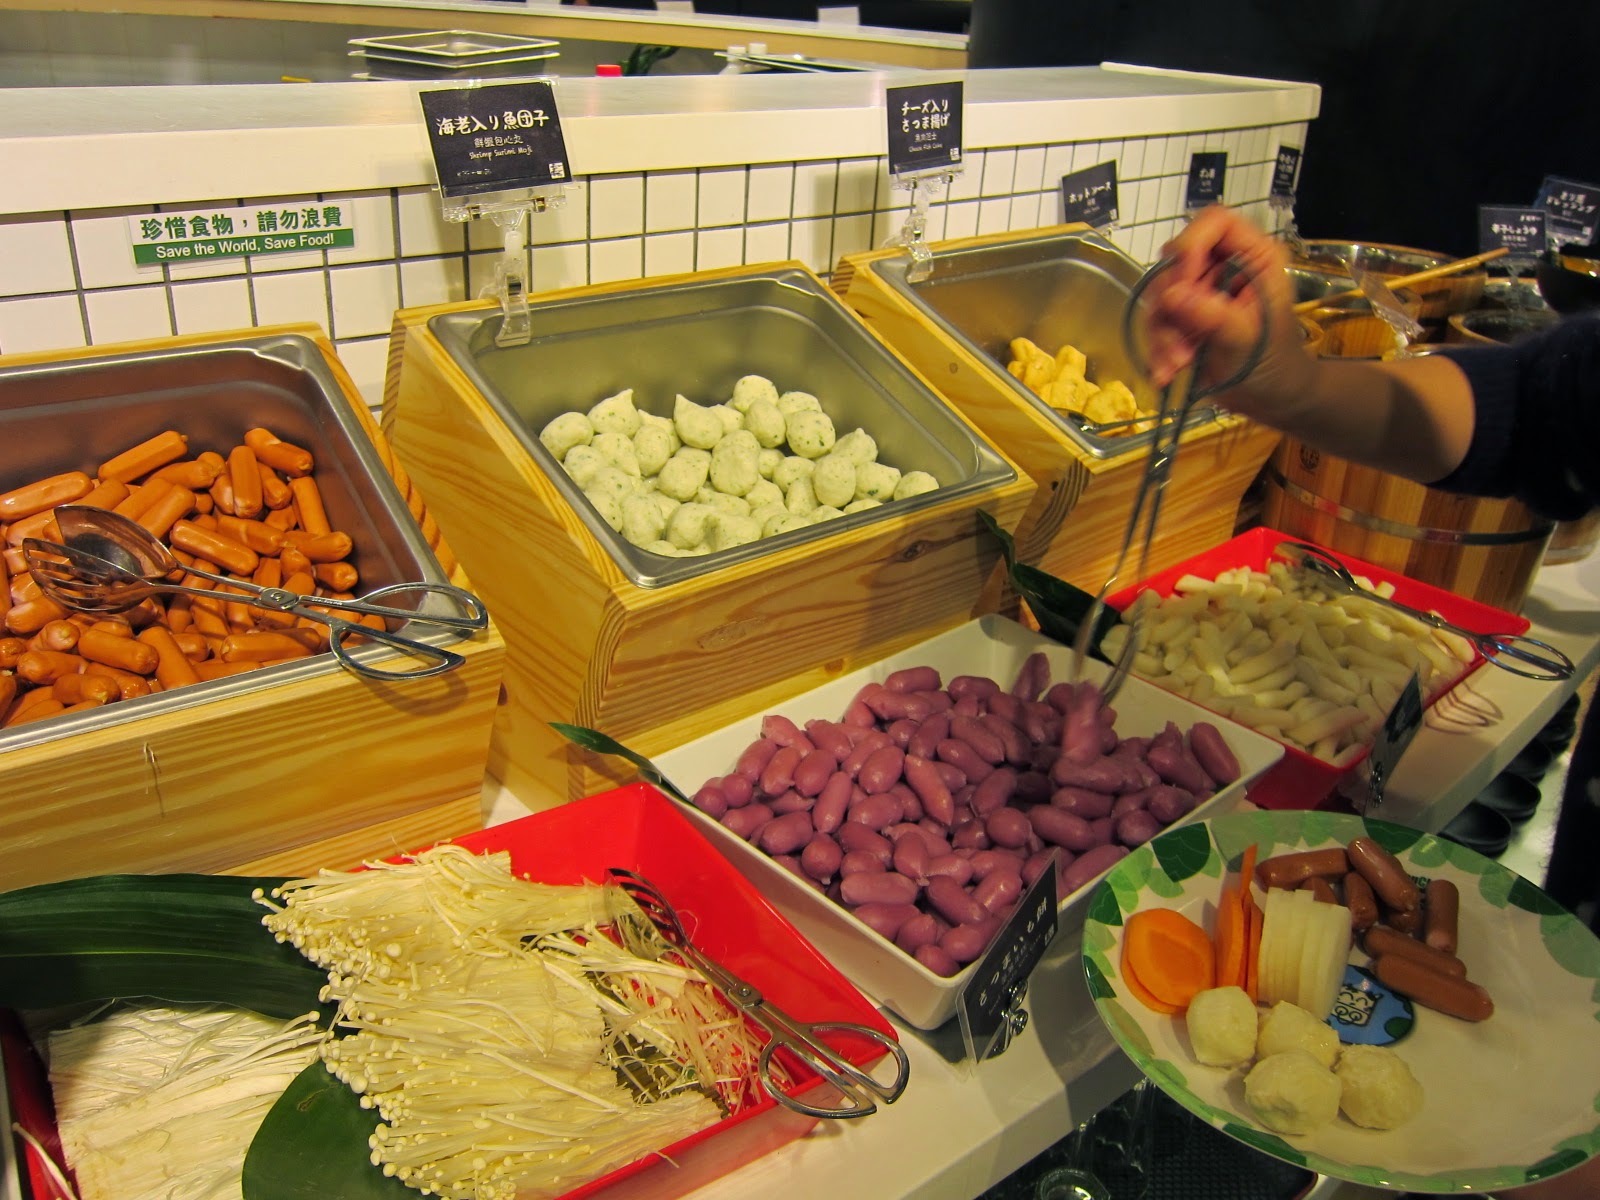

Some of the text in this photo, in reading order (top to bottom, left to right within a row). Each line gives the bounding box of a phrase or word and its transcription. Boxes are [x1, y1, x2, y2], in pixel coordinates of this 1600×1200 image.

[901, 99, 949, 116] チーズ入り
[435, 109, 550, 136] 海老入り魚団子
[469, 150, 492, 161] Shrimp
[140, 206, 342, 240] 珍惜食物，請勿浪費
[156, 233, 335, 259] Save the World, Save Food!
